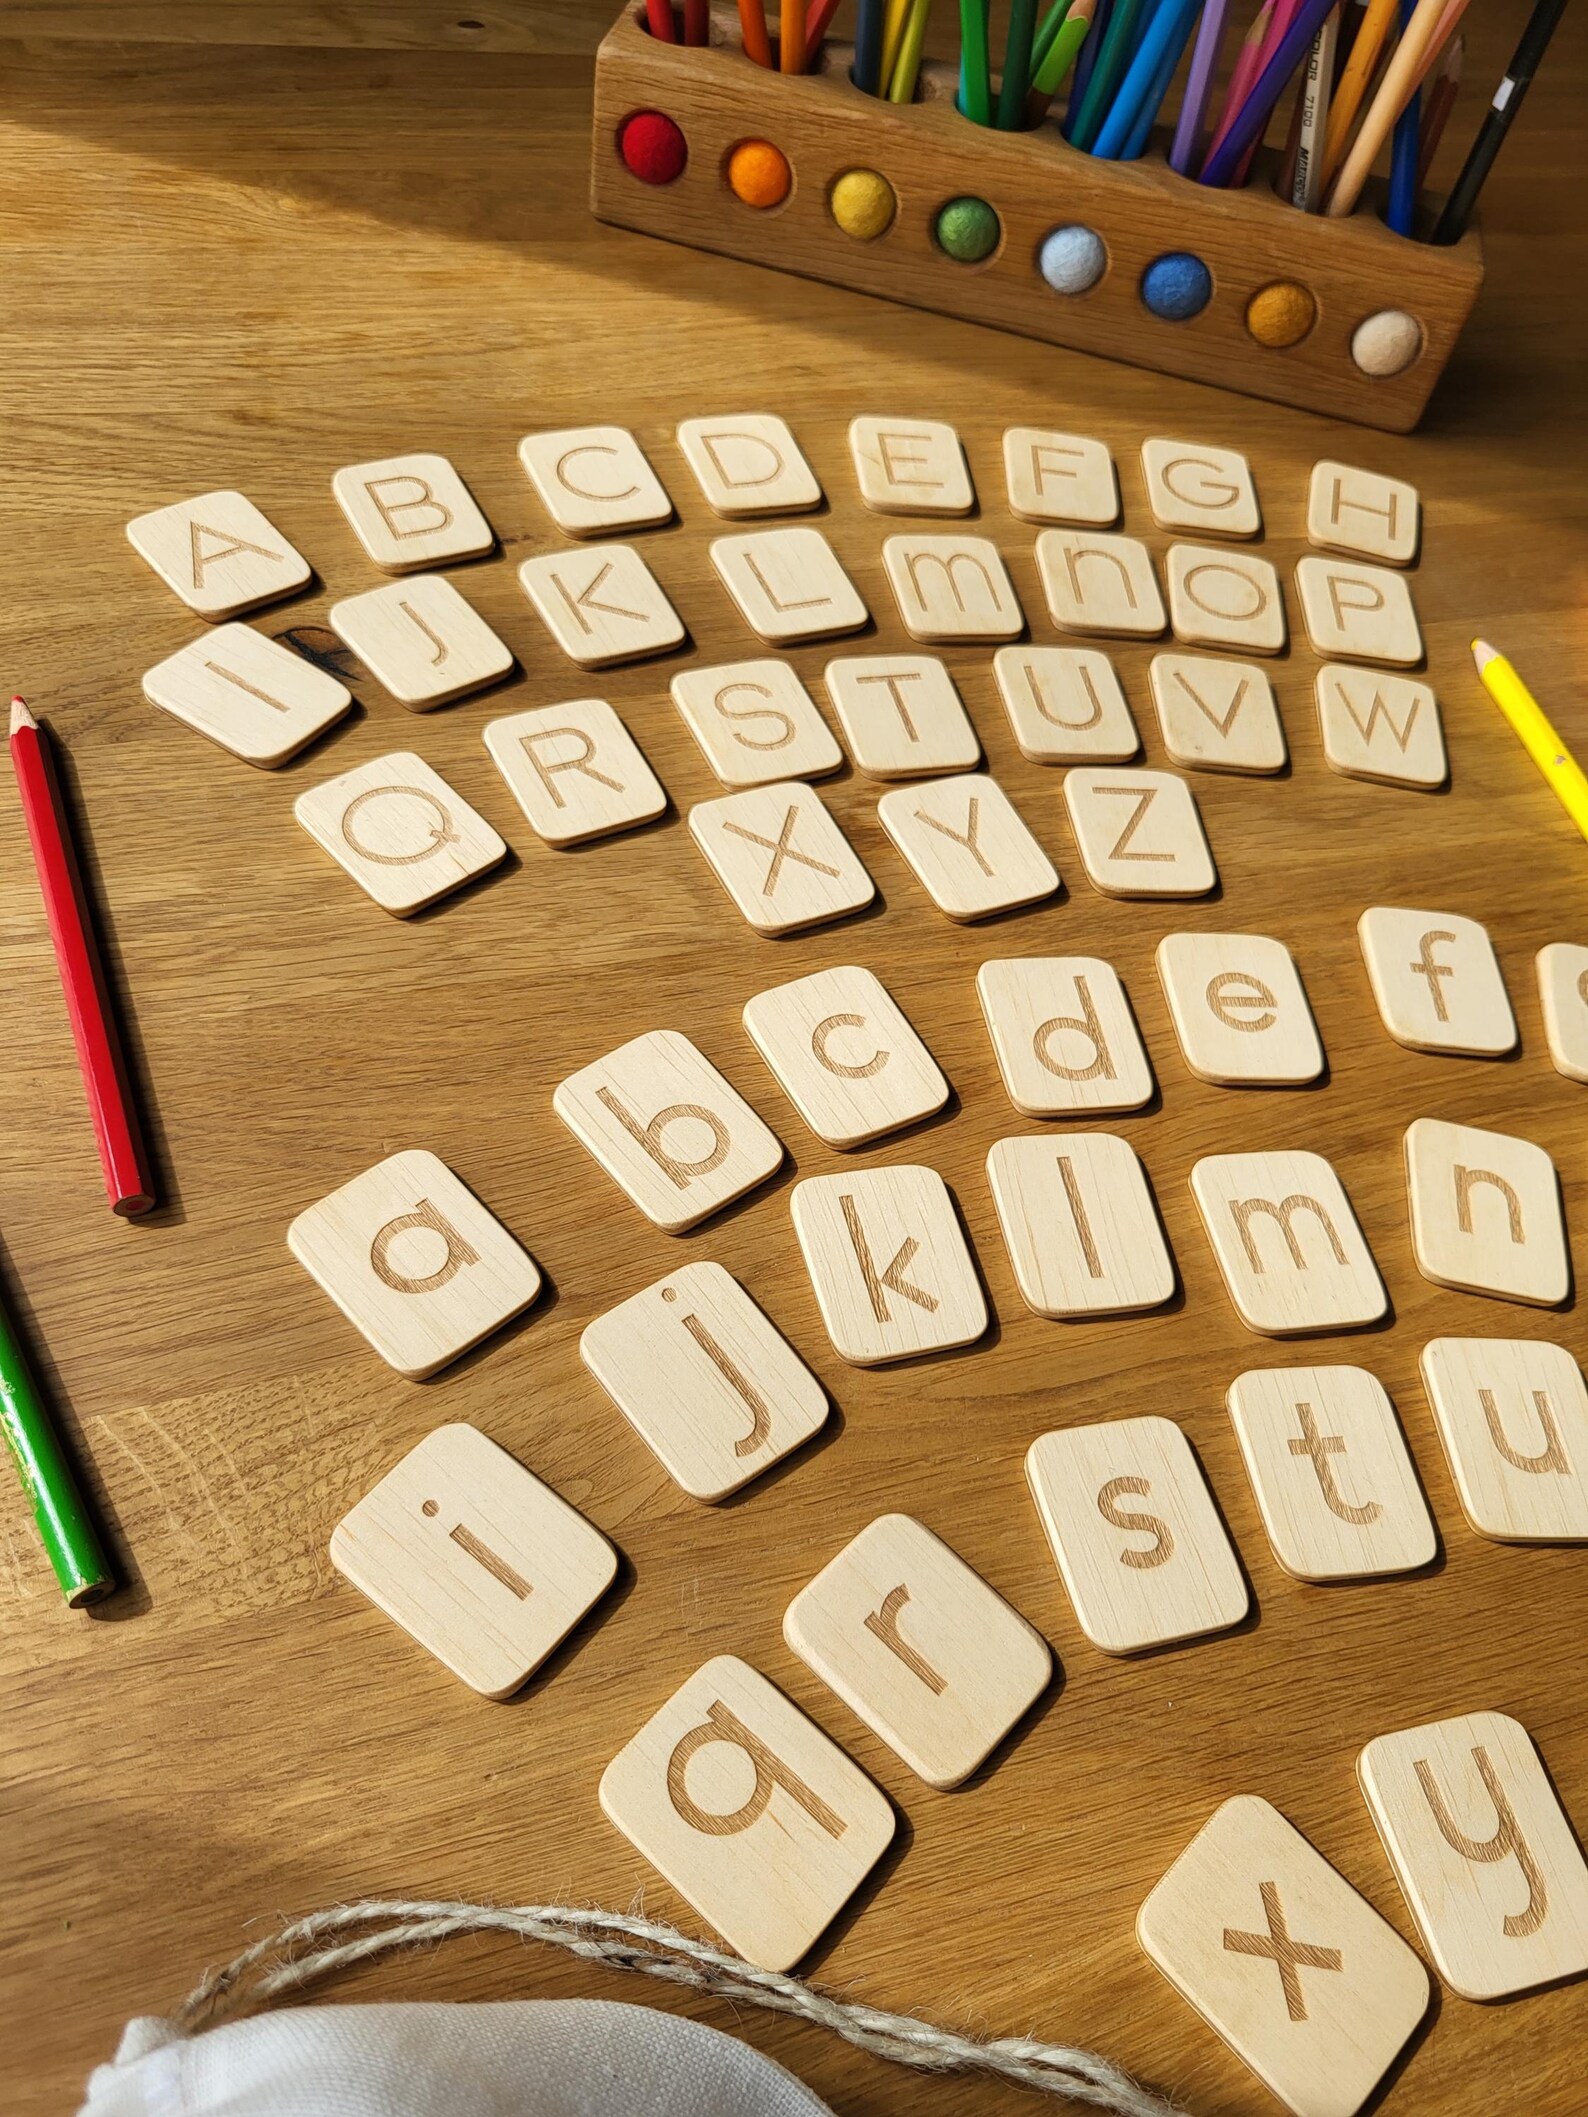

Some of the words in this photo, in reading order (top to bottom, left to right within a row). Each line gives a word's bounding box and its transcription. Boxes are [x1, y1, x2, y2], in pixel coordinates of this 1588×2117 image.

[1303, 96, 1315, 128] 7100
[557, 446, 641, 502] C
[702, 434, 785, 489] D
[878, 433, 944, 489] E
[1030, 445, 1085, 497] F
[1162, 458, 1240, 509] G
[365, 476, 453, 541] B
[1331, 478, 1398, 541] H
[190, 520, 283, 589] A
[745, 553, 832, 612] L
[551, 563, 650, 634] K
[1183, 564, 1267, 621] O
[1327, 575, 1385, 631] P
[399, 602, 448, 666] J
[715, 683, 797, 751] S
[857, 673, 922, 743] T
[1024, 665, 1103, 731] U
[1173, 672, 1249, 739] V
[1336, 682, 1421, 754] W
[518, 728, 626, 808] R
[342, 785, 460, 866] Q
[723, 805, 841, 896] X
[914, 797, 997, 877] Y
[1092, 787, 1177, 862] Z
[1205, 971, 1278, 1032] e
[1411, 930, 1457, 1022] f
[811, 1013, 891, 1080] c
[1033, 975, 1117, 1082] d
[595, 1086, 732, 1190] b
[1228, 1193, 1351, 1274] m
[1453, 1163, 1526, 1245] n
[370, 1198, 482, 1295] a
[838, 1195, 941, 1323] k
[661, 1287, 772, 1458] j
[1287, 1403, 1384, 1525] t
[1478, 1388, 1572, 1476] u
[421, 1499, 535, 1602] i
[1097, 1475, 1176, 1571] s
[863, 1582, 950, 1696] r
[667, 1698, 850, 1840] q
[1412, 1746, 1550, 1939] y
[1222, 1879, 1344, 2024] x
